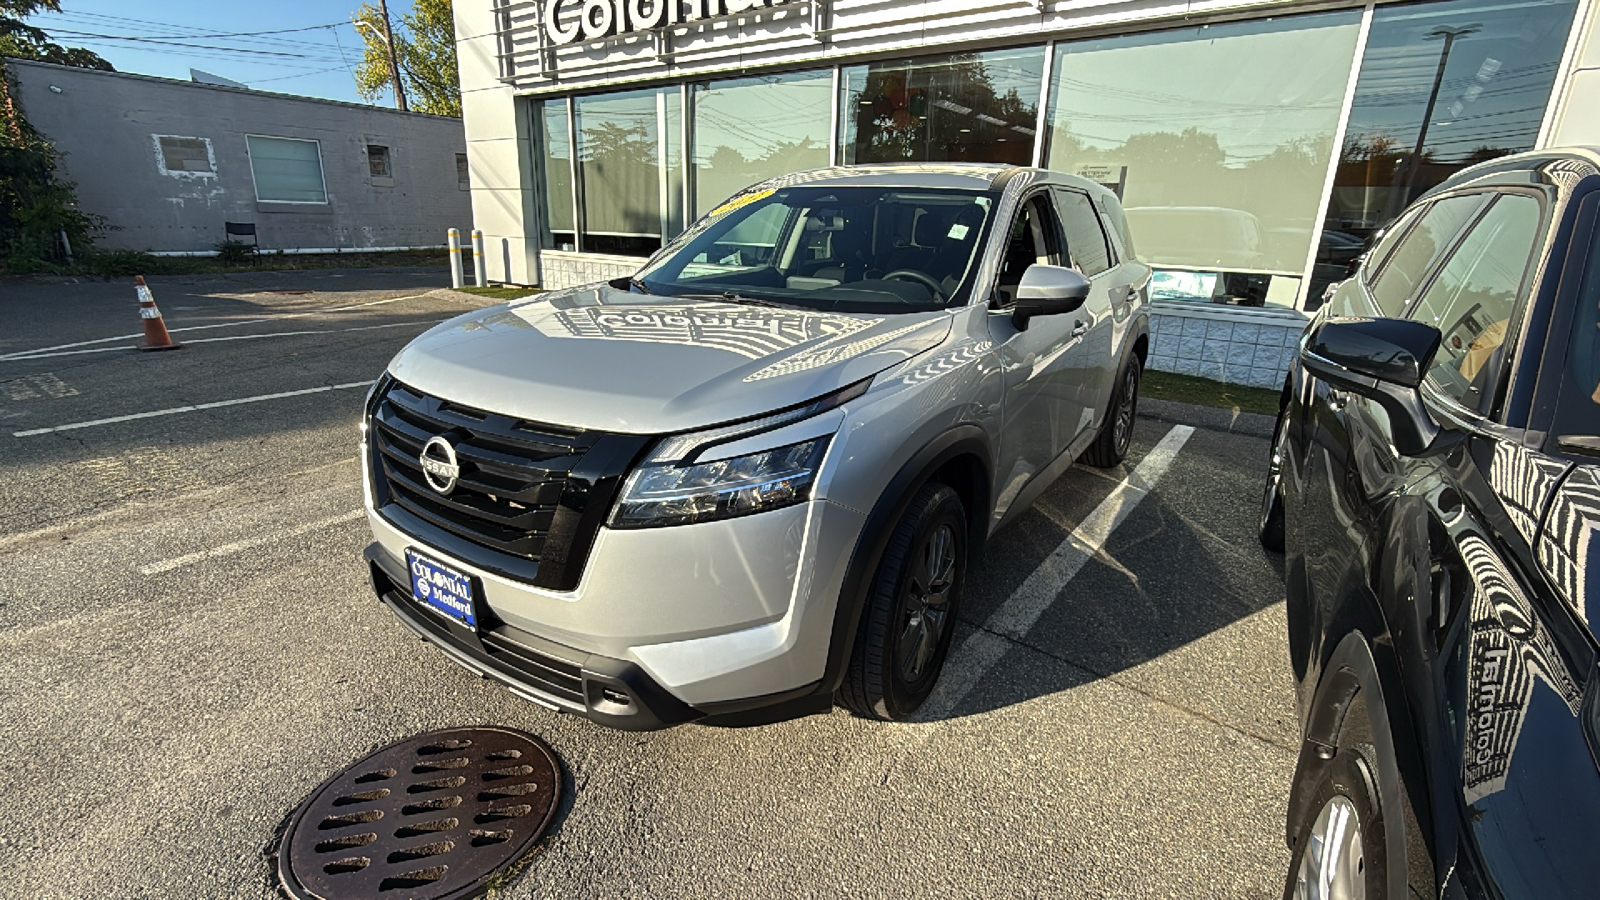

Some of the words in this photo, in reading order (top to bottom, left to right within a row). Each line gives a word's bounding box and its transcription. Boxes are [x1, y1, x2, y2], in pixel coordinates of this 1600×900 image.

[545, 0, 785, 45] Colon
[412, 561, 472, 601] COLONIAL
[432, 586, 472, 616] Medford
